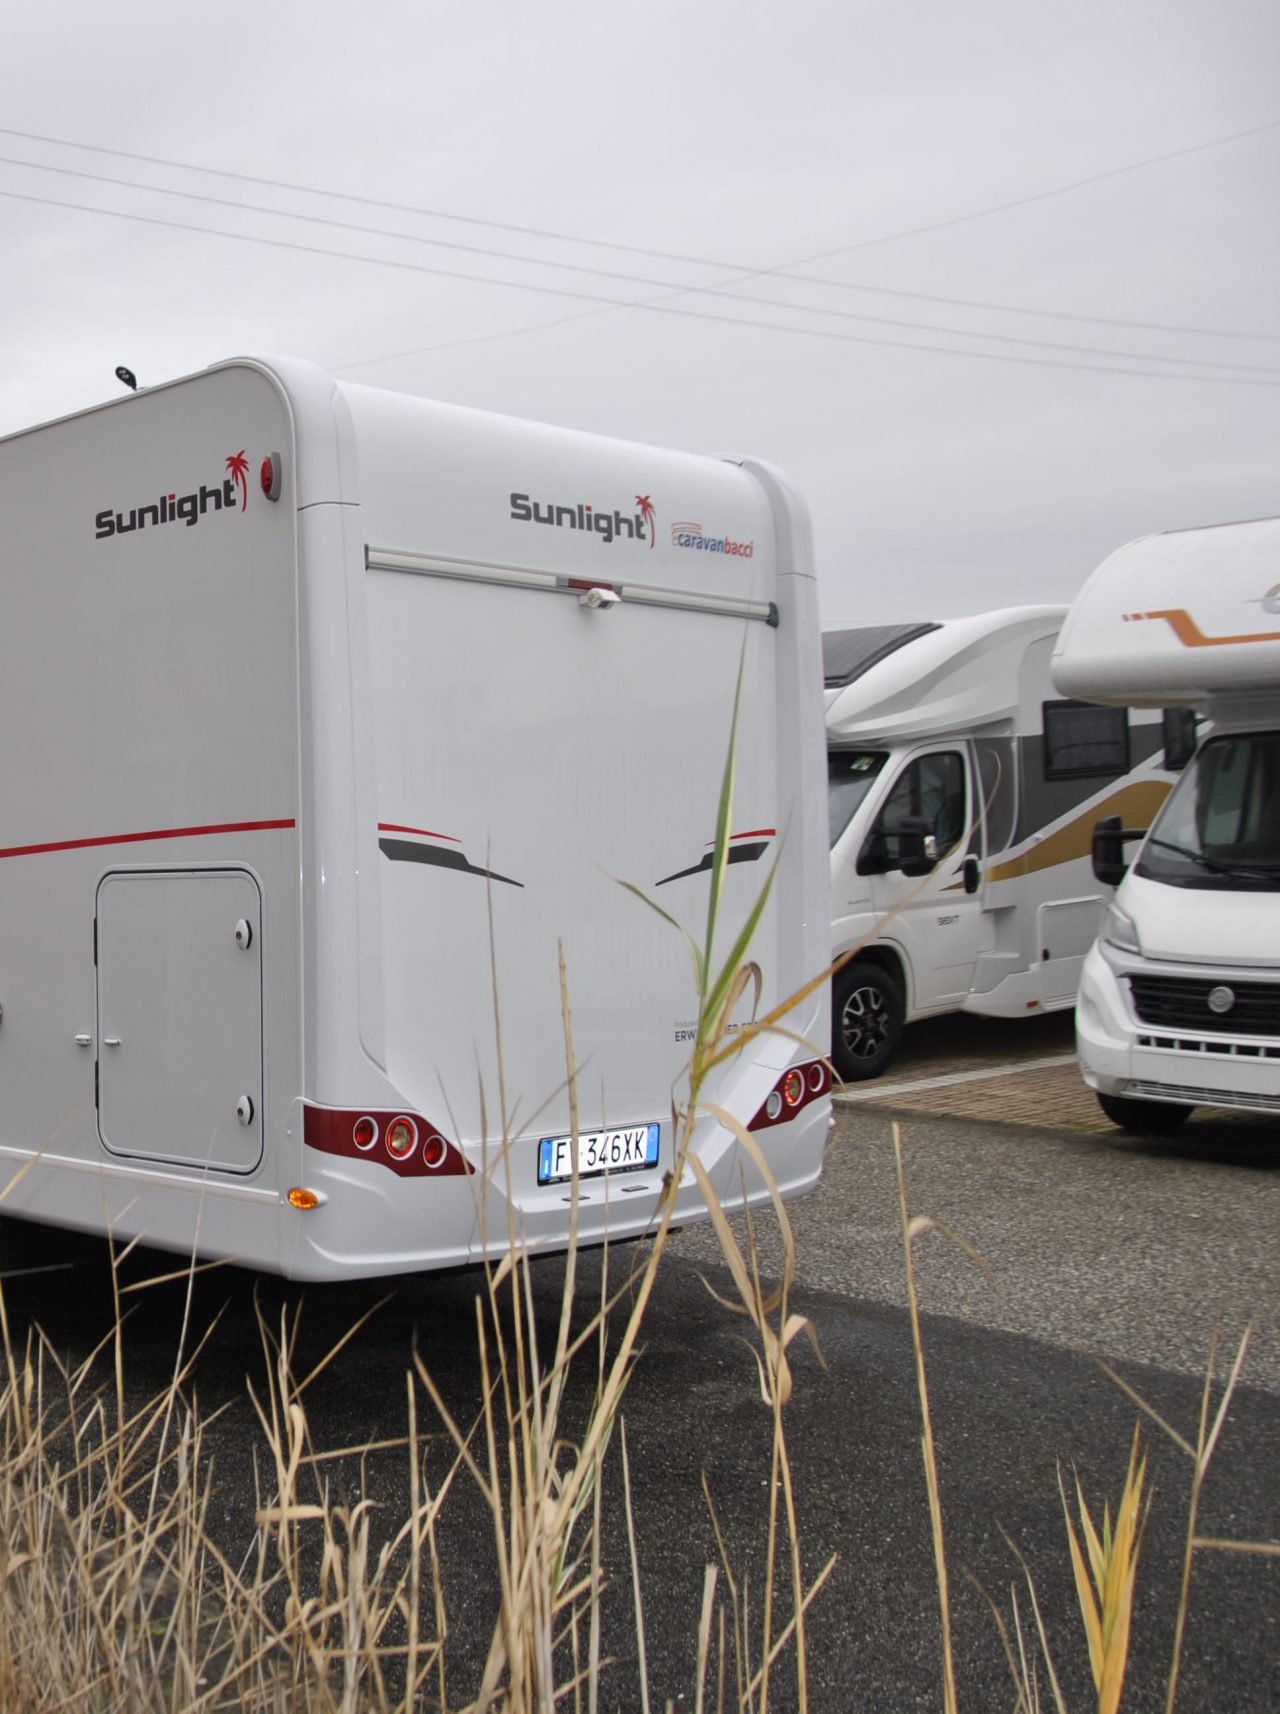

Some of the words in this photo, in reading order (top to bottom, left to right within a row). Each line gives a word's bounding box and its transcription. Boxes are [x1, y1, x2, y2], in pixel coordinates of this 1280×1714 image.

[96, 480, 236, 539] Sunlight
[511, 493, 646, 543] Sunlight
[678, 533, 753, 558] caravanbacci
